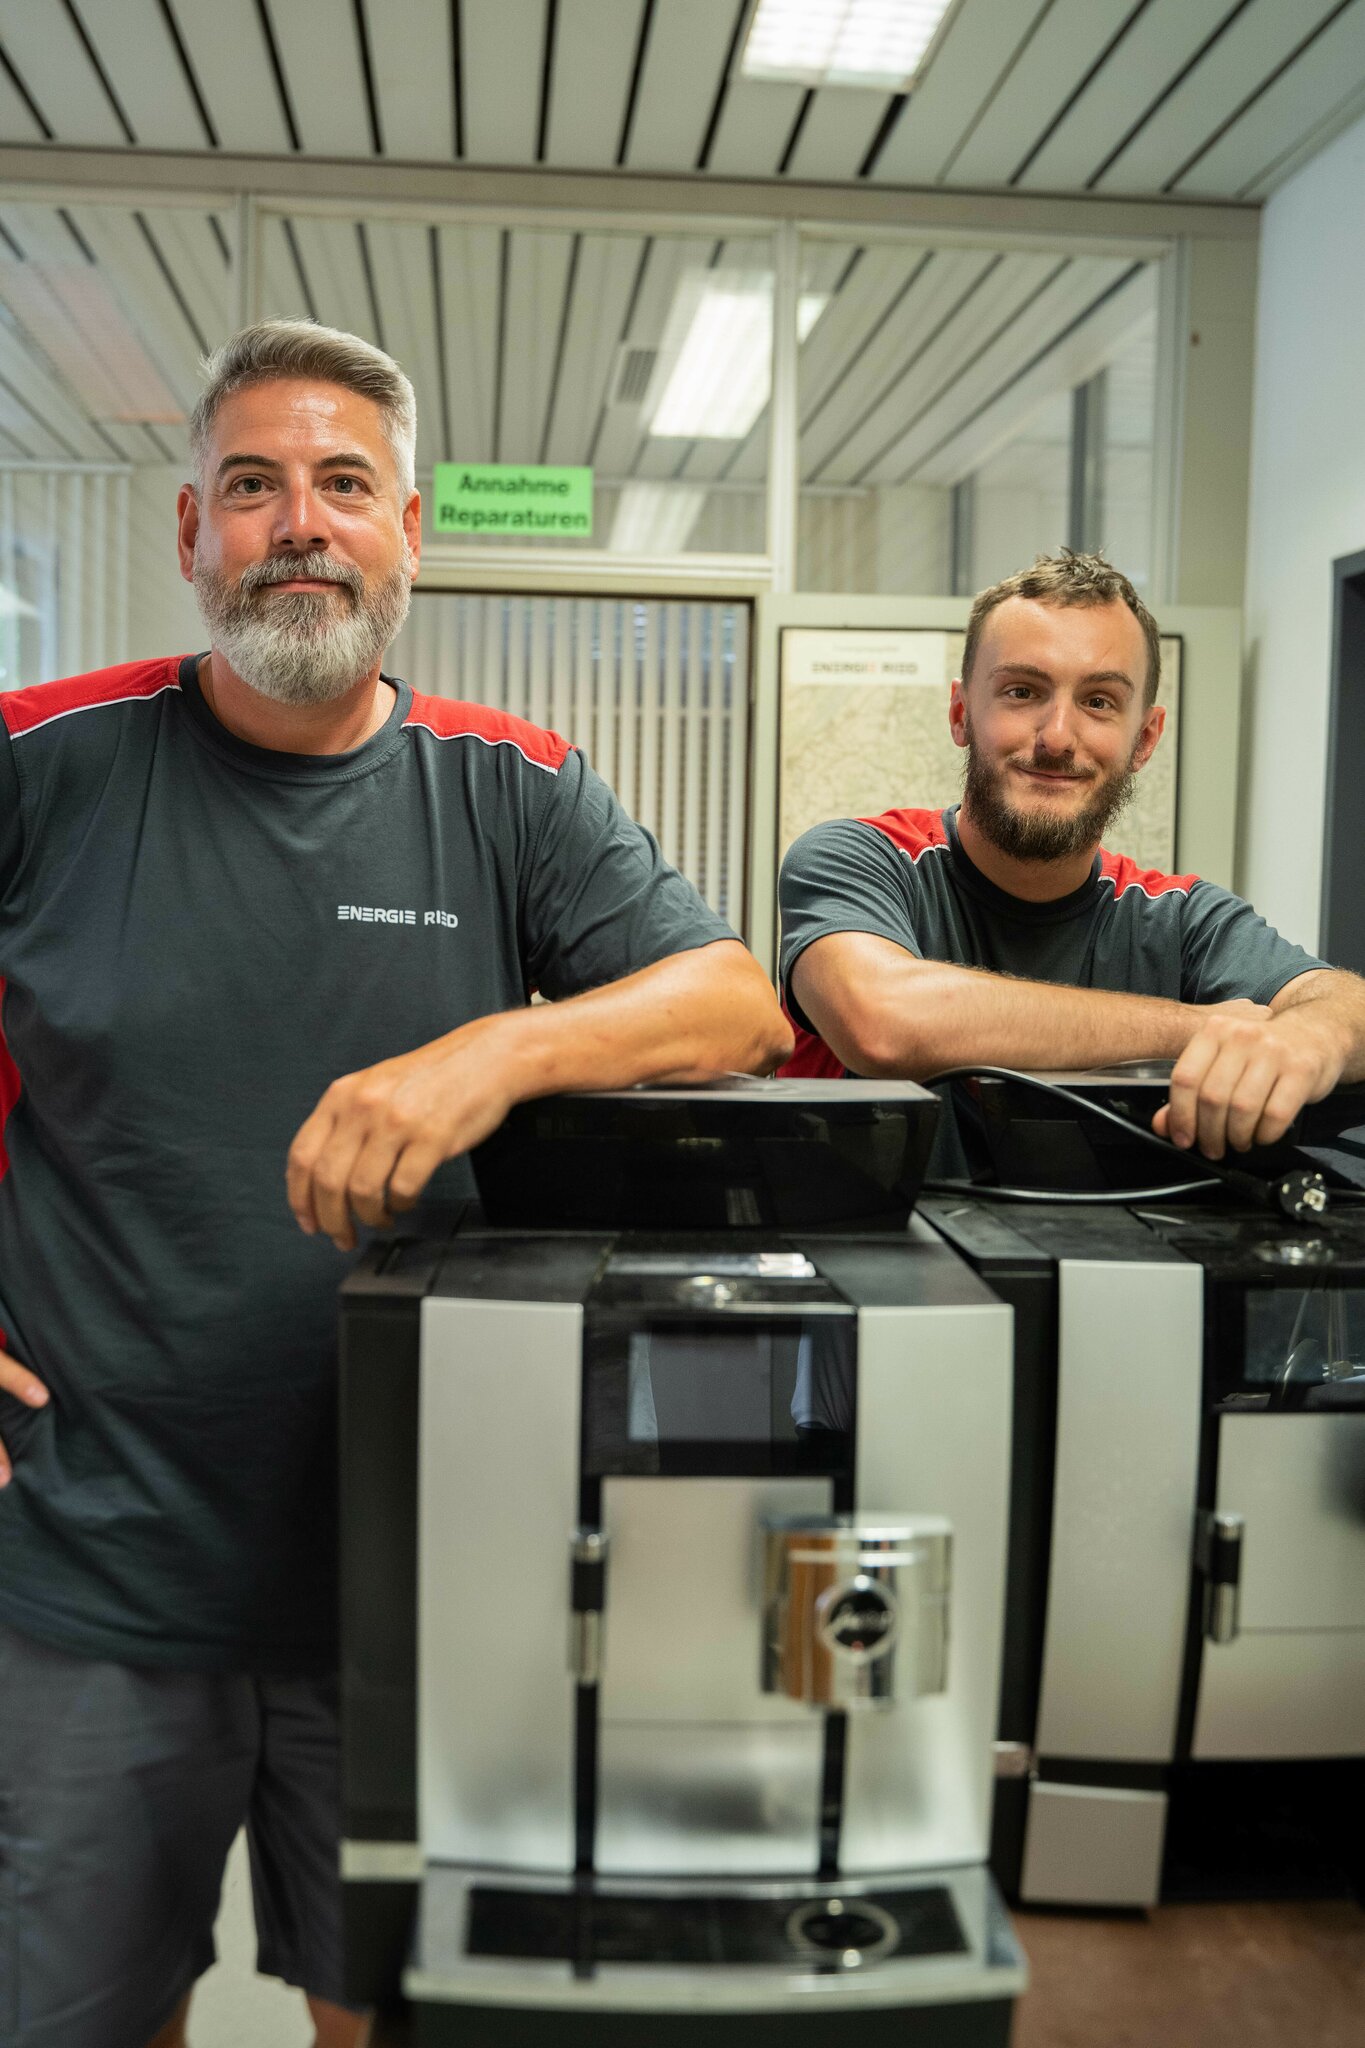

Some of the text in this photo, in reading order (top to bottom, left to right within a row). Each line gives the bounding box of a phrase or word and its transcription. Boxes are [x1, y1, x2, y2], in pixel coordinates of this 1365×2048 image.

[458, 473, 570, 497] Annahme
[439, 504, 589, 529] Reparaturen
[337, 905, 459, 928] ENERGIE RIED
